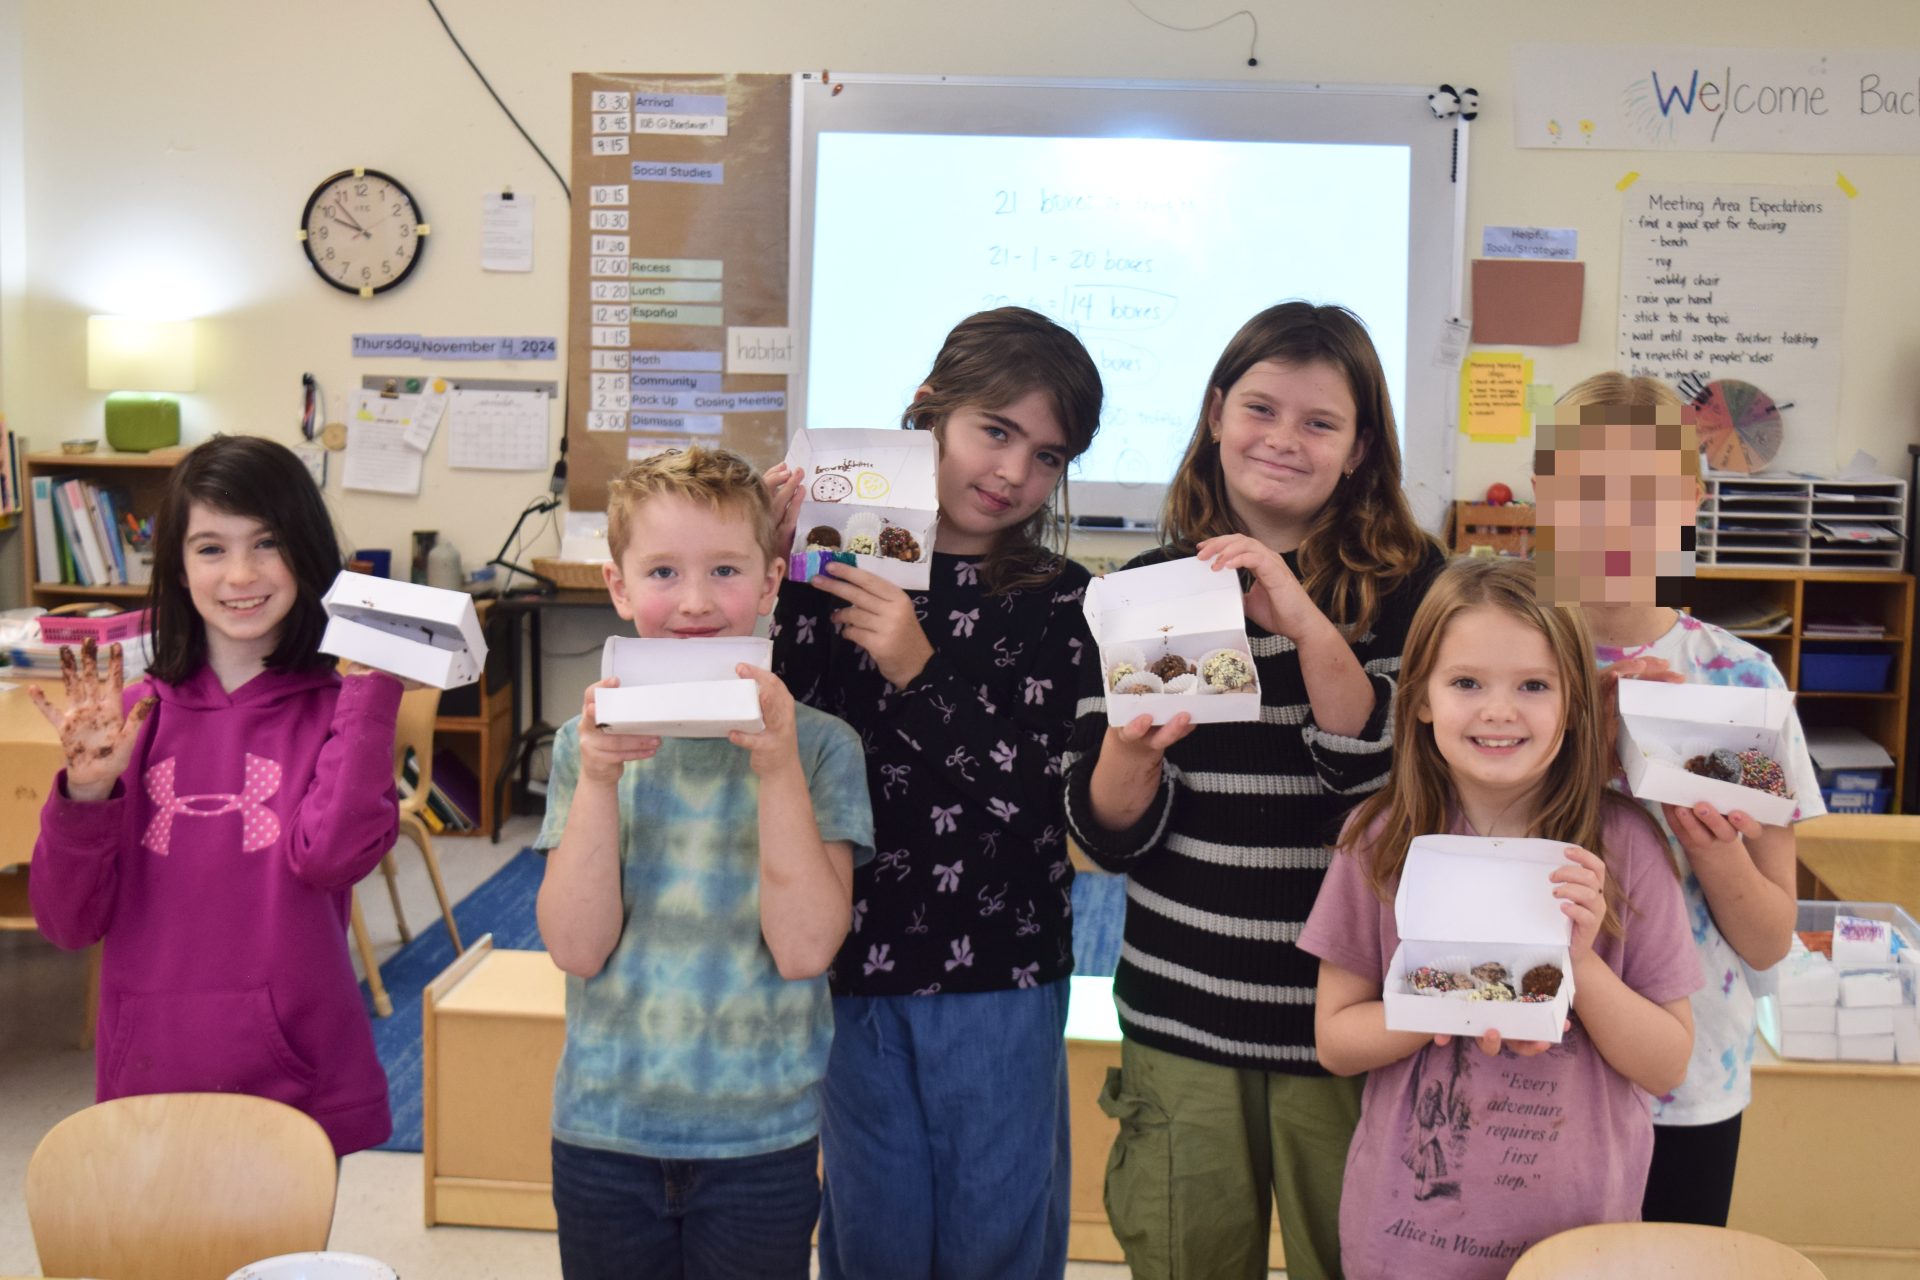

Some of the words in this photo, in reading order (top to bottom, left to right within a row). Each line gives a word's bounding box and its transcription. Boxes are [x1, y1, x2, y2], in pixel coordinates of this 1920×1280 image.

[636, 97, 674, 108] Arrival
[1652, 67, 1828, 142] Welcome
[1860, 73, 1920, 117] Bac
[633, 165, 667, 177] Social
[671, 166, 712, 178] Studies
[336, 190, 349, 202] 11
[354, 184, 369, 197] 12
[995, 190, 1016, 214] 21
[1649, 195, 1704, 217] Meeting
[1712, 195, 1741, 212] Area
[1750, 197, 1823, 216] Expectations
[322, 205, 336, 218] 10
[392, 204, 401, 217] 2
[401, 224, 409, 236] 3
[1639, 215, 1659, 229] find
[1666, 219, 1673, 229] a
[1677, 219, 1698, 233] good
[1703, 218, 1720, 232] spot
[1727, 216, 1740, 229] for
[320, 228, 328, 239] 9
[1660, 235, 1688, 247] bench
[326, 248, 335, 260] 8
[396, 246, 405, 257] 4
[341, 261, 350, 273] 7
[382, 261, 391, 273] 5
[1070, 250, 1095, 269] 20
[1104, 249, 1154, 272] boxes
[1655, 257, 1672, 271] rug
[361, 267, 371, 279] 6
[632, 263, 671, 273] Recess
[1693, 274, 1720, 286] chair
[632, 286, 665, 296] Lunch
[1688, 291, 1713, 305] hand
[632, 308, 677, 319] Español
[1111, 296, 1160, 320] boxes
[1634, 311, 1660, 322] stick
[1669, 312, 1678, 323] to
[1684, 312, 1699, 323] the
[422, 340, 496, 353] November
[521, 340, 555, 353] 2024
[737, 334, 794, 363] habitat
[632, 355, 661, 365] Math
[632, 375, 697, 388] Community
[632, 395, 658, 404] Pack
[662, 395, 678, 406] Up
[694, 396, 735, 408] Closing
[738, 394, 784, 407] Meeting
[632, 415, 684, 426] Dismissal
[1487, 1096, 1563, 1117] adventure
[1485, 1124, 1546, 1142] requires
[1549, 1130, 1559, 1142] a
[1500, 1147, 1538, 1165] first
[1385, 1218, 1427, 1242] Alice
[1430, 1229, 1446, 1249] in
[1453, 1234, 1528, 1258] Wonderl
